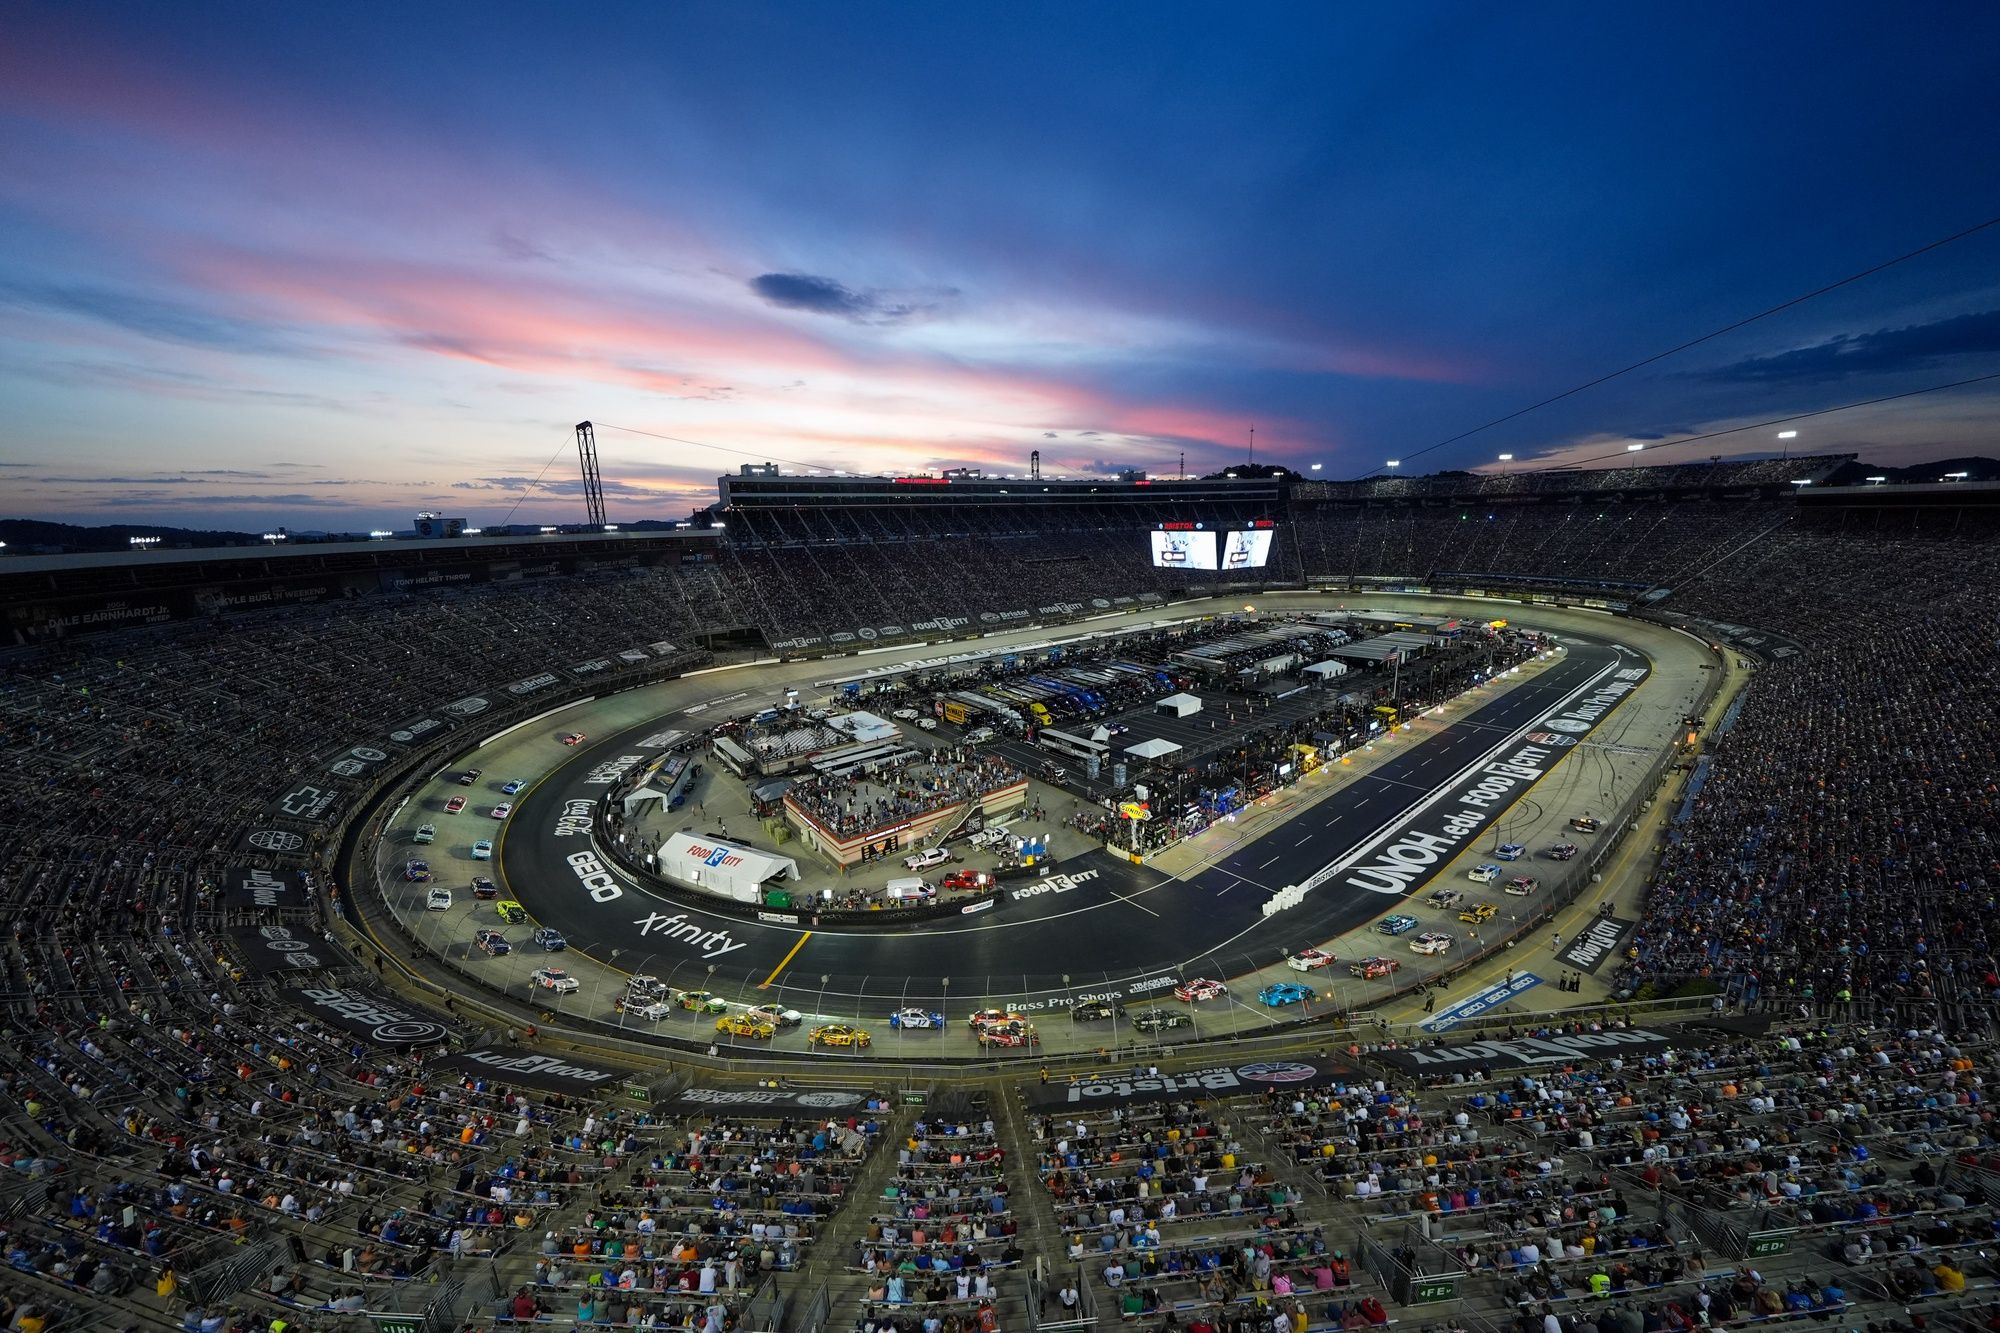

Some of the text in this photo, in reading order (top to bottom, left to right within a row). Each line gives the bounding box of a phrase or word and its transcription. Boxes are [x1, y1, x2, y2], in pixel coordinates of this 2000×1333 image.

[395, 578, 414, 587] TONY
[415, 575, 444, 584] HELMET
[445, 573, 471, 581] THROW
[284, 586, 327, 598] WEEKEND
[1000, 609, 1029, 620] Bristol
[1038, 602, 1084, 614] FOOD CITY
[48, 605, 170, 630] DALE EARNHARDT Jr.
[911, 617, 970, 631] FOOD CITY
[773, 636, 823, 649] FOOD CITY
[521, 673, 556, 688] Bristol
[1561, 703, 1606, 721] Bass
[587, 755, 645, 784] BUSCH
[306, 790, 339, 819] CHEVROLET
[1120, 804, 1150, 819] SUNOCO
[1346, 809, 1486, 894] UNOH.edu
[1459, 777, 1516, 808] FOOD
[1508, 745, 1552, 766] CITY
[686, 844, 743, 867] FOOD CITY
[566, 850, 623, 903] GEICO
[1011, 883, 1050, 901] FOOD
[1069, 868, 1100, 884] CITY
[1312, 868, 1336, 887] BRISTOL
[633, 911, 748, 959] xfinity
[1566, 919, 1623, 968] FOOD CITY
[1130, 976, 1172, 990] TRACKER
[1510, 976, 1535, 991] GEICO
[1006, 989, 1123, 1013] Bass Pro Shops
[1485, 988, 1512, 1004] GEICO
[302, 988, 401, 1025] state
[1458, 1001, 1486, 1018] GEICO
[1168, 1017, 1178, 1026] 41
[1010, 1035, 1020, 1044] 10
[1409, 1029, 1670, 1064] FOOD CITY
[463, 1051, 613, 1082] FOOD CITY
[1070, 1066, 1231, 1087] Motor Speedway
[1068, 1071, 1241, 1102] Bristol
[1427, 1287, 1445, 1297] FE
